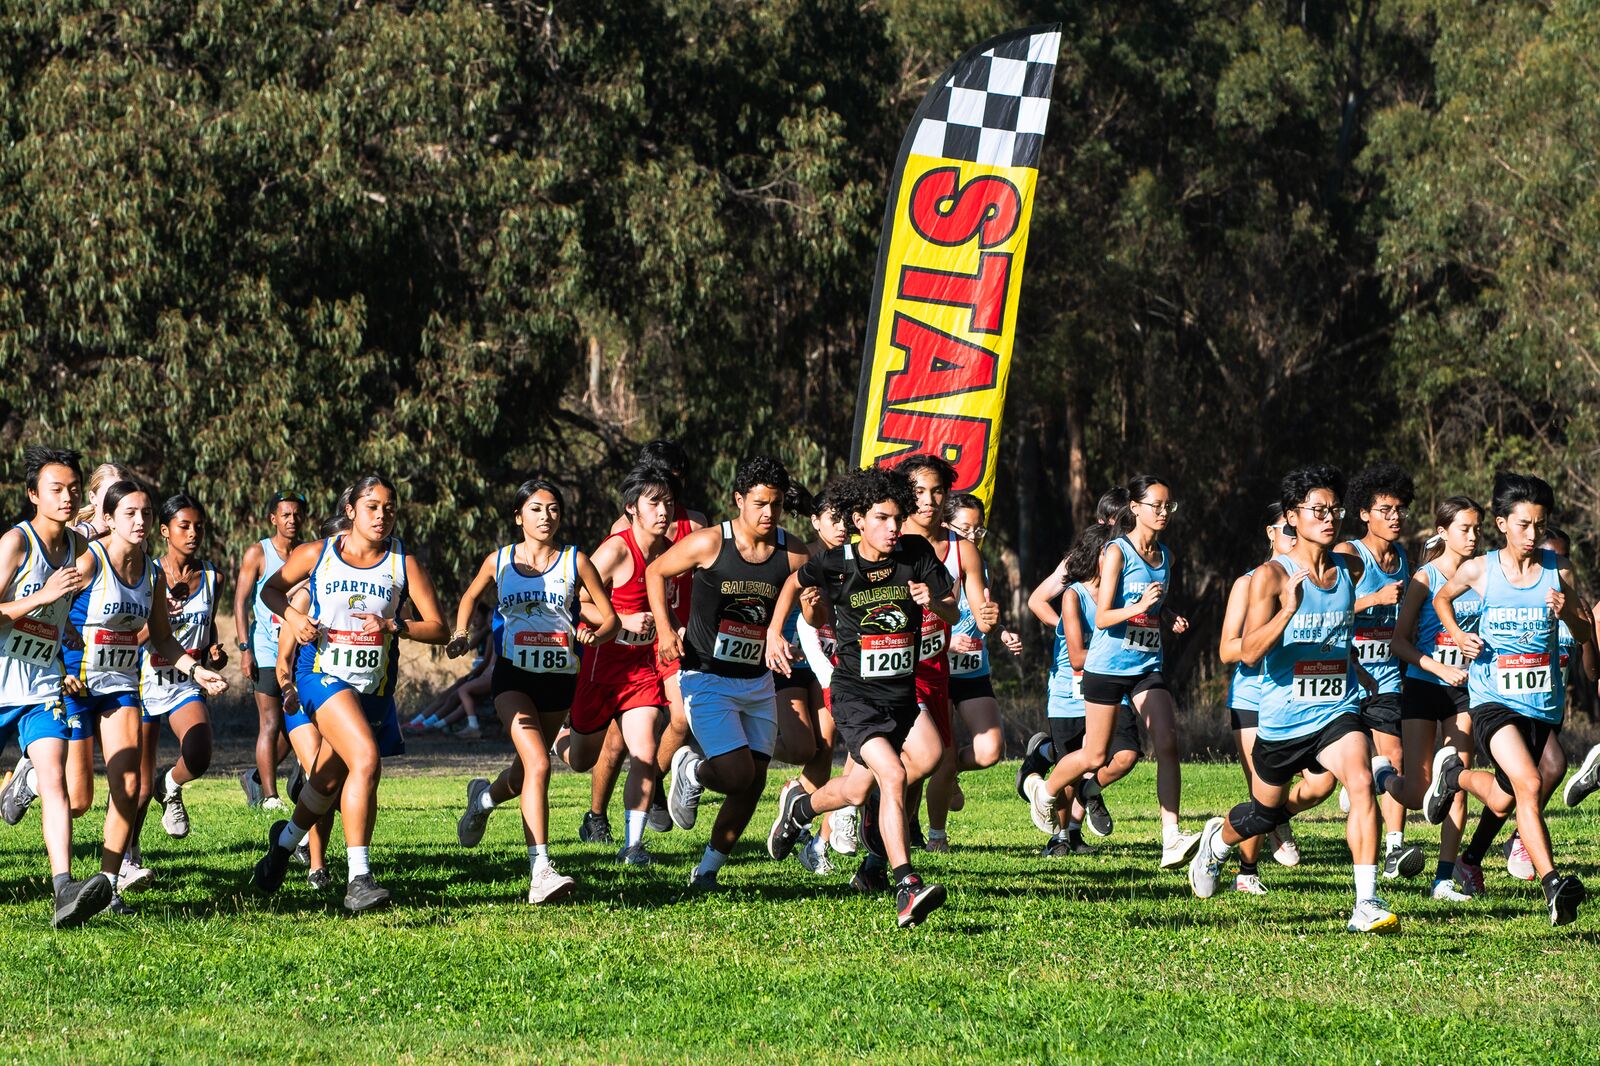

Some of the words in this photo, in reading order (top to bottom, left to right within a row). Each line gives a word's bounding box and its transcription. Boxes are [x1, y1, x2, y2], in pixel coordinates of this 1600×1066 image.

[874, 166, 1021, 495] STAR
[325, 579, 392, 602] SPARTANS
[502, 590, 564, 608] SPARTANS
[103, 601, 149, 618] SPARTAN
[728, 625, 741, 633] RACE
[1293, 629, 1322, 639] CROSS
[1489, 622, 1518, 631] CROSS
[11, 635, 54, 662] 1174
[870, 638, 885, 646] RACE
[890, 636, 909, 645] RESULT
[922, 635, 942, 655] 55
[1129, 630, 1160, 648] 1122
[97, 648, 136, 667] 1177
[330, 648, 379, 668] 1188
[720, 638, 762, 660] 1202
[518, 649, 567, 669] 1185
[866, 650, 912, 672] 1203
[951, 654, 980, 670] 146
[154, 668, 189, 687] 118
[1502, 670, 1547, 690] 1107
[1297, 678, 1343, 697] 1128
